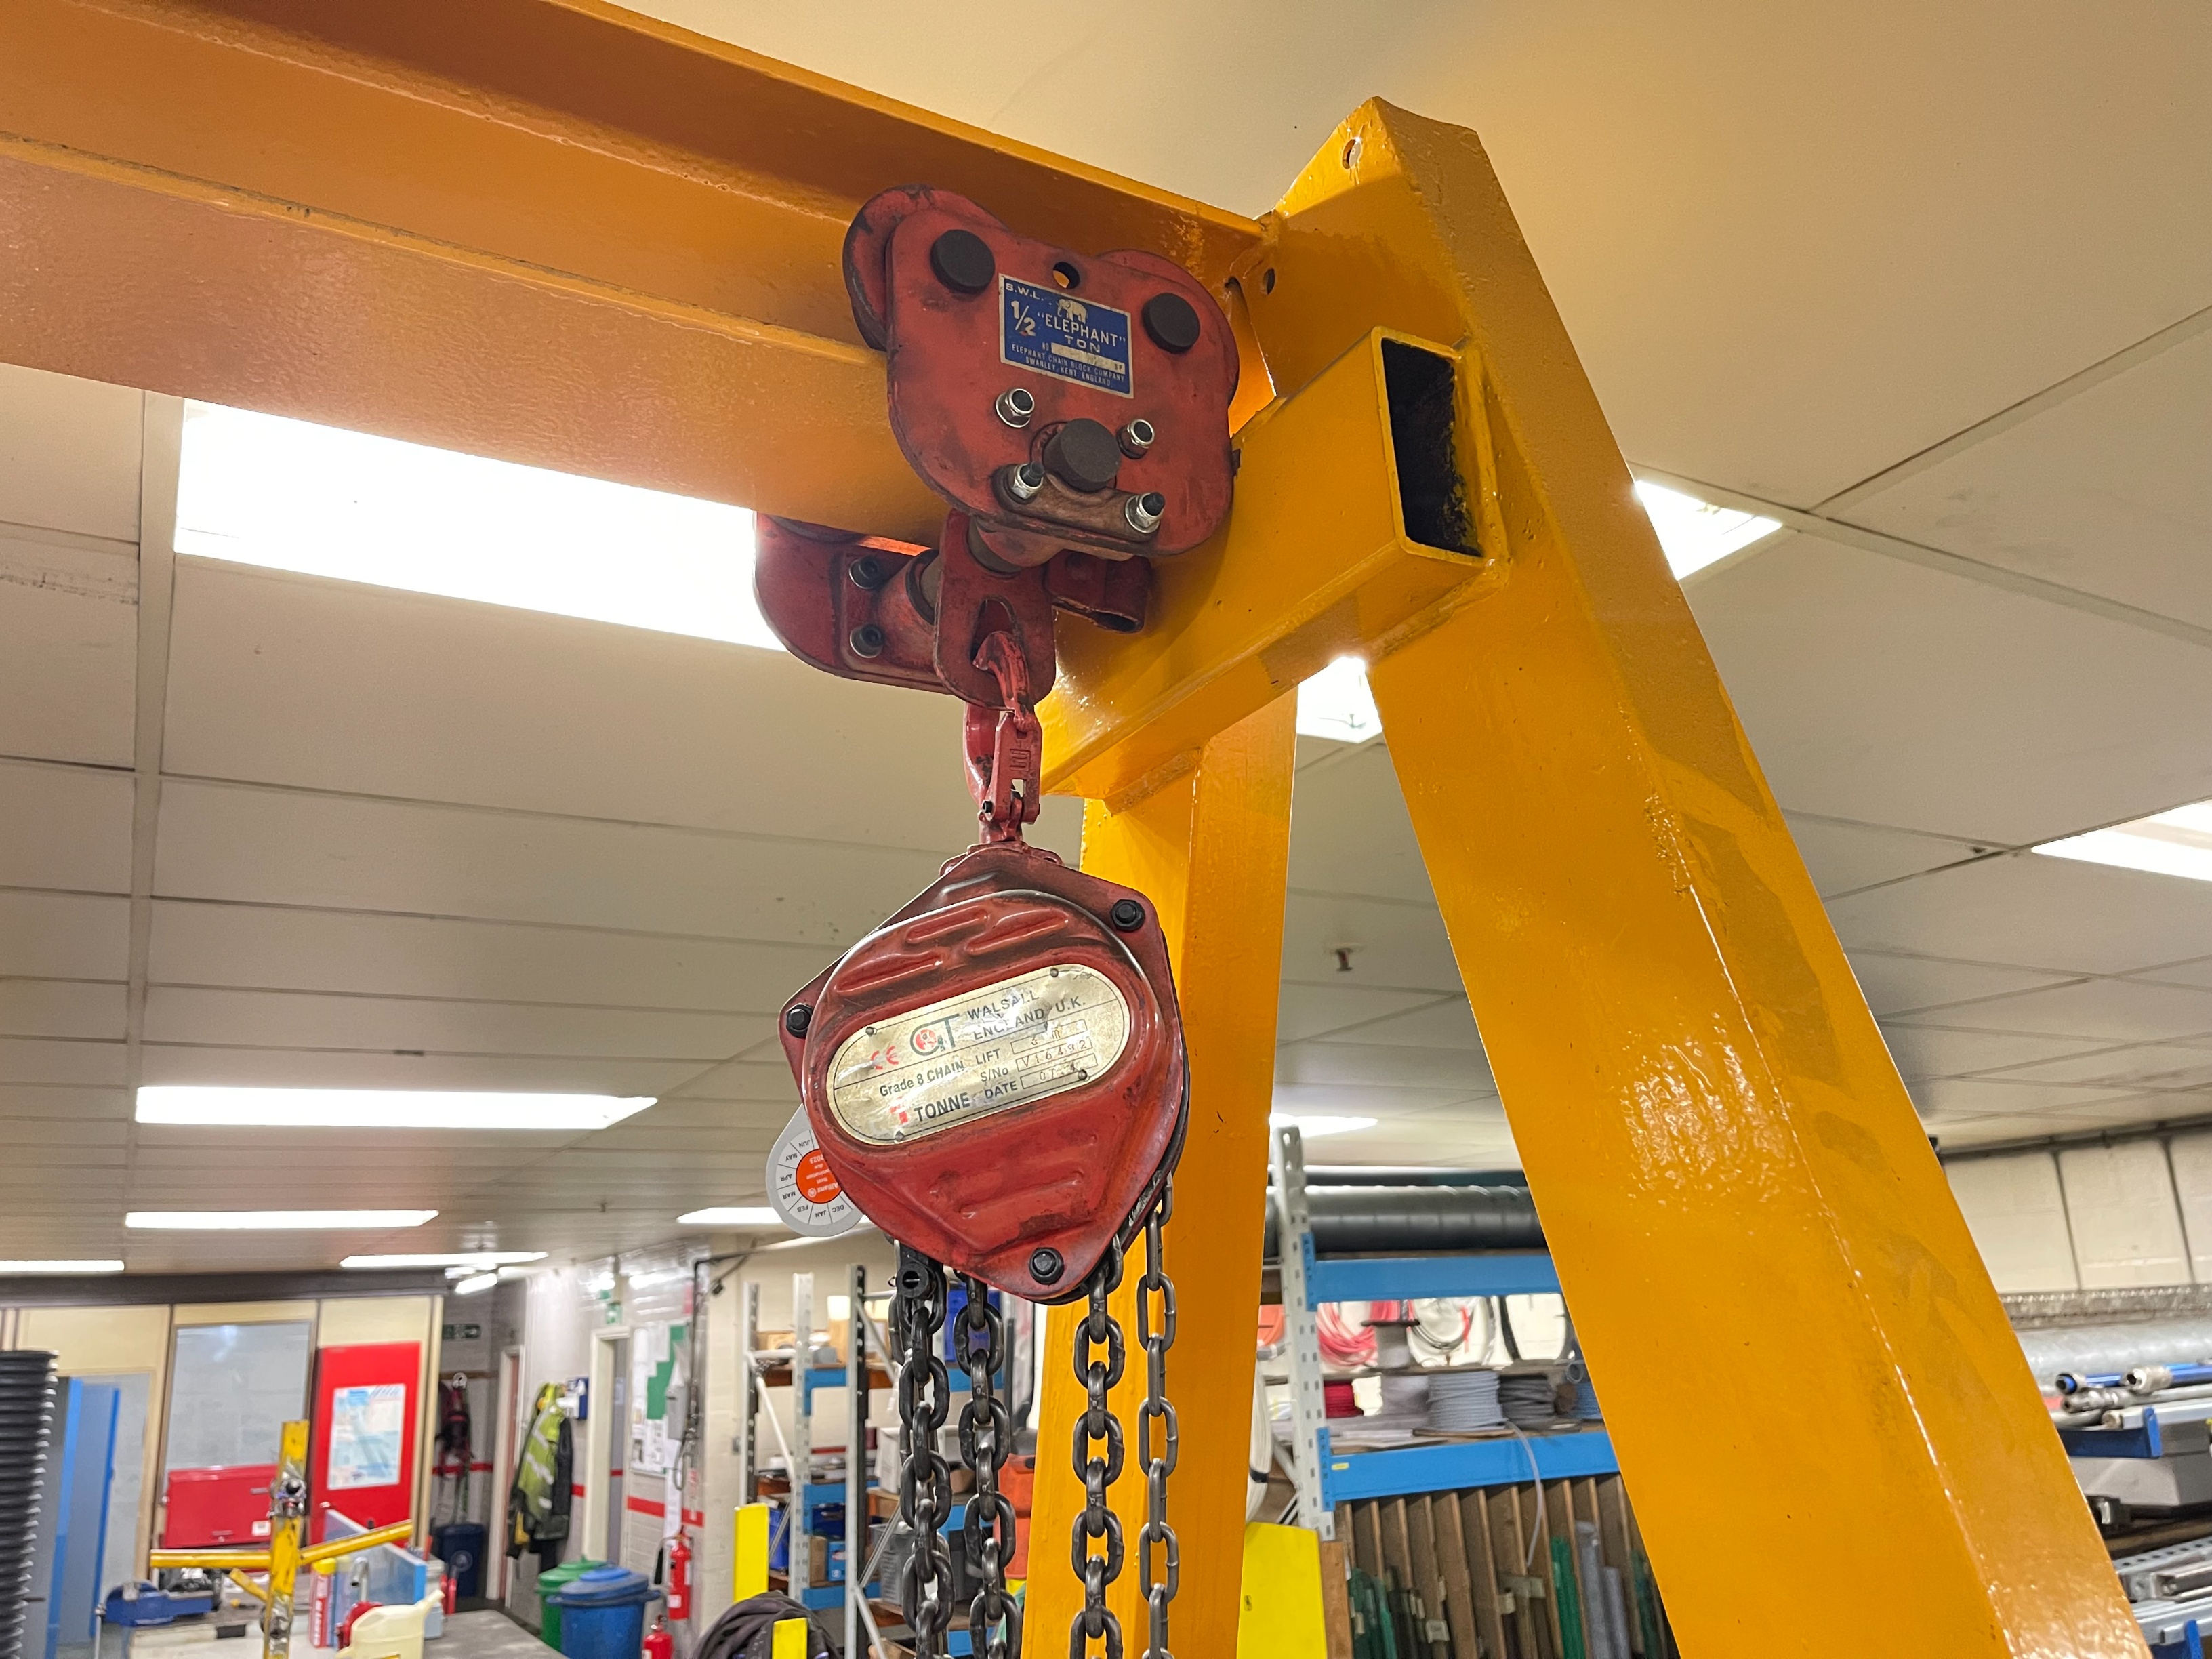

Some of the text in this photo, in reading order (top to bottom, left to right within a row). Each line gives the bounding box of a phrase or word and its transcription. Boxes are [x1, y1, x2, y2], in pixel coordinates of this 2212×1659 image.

[1006, 283, 1044, 301] S.W.L.
[1010, 300, 1036, 337] 1/2
[1065, 335, 1100, 353] TON
[1012, 344, 1045, 361] ELEPHANT
[1048, 354, 1068, 367] CHAIN
[1071, 361, 1091, 373] BLOCK
[1094, 368, 1125, 383] COMPANY
[1060, 365, 1077, 377] KENT
[967, 990, 1039, 1020] WALSALL
[1055, 996, 1086, 1012] U.K.
[975, 1048, 1000, 1065] LIFT
[879, 1060, 965, 1097] Grade 8 CHAIN
[980, 1067, 1008, 1082] S/No
[985, 1080, 1018, 1099] DATE
[914, 1092, 971, 1122] TONNE
[798, 1139, 811, 1148] JUN
[785, 1153, 798, 1162] MAY
[810, 1154, 825, 1164] 2023
[780, 1173, 792, 1182] APR
[782, 1191, 796, 1200] MAR
[797, 1204, 808, 1212] FEB
[815, 1210, 827, 1218] JAN
[832, 1204, 844, 1213] DEC
